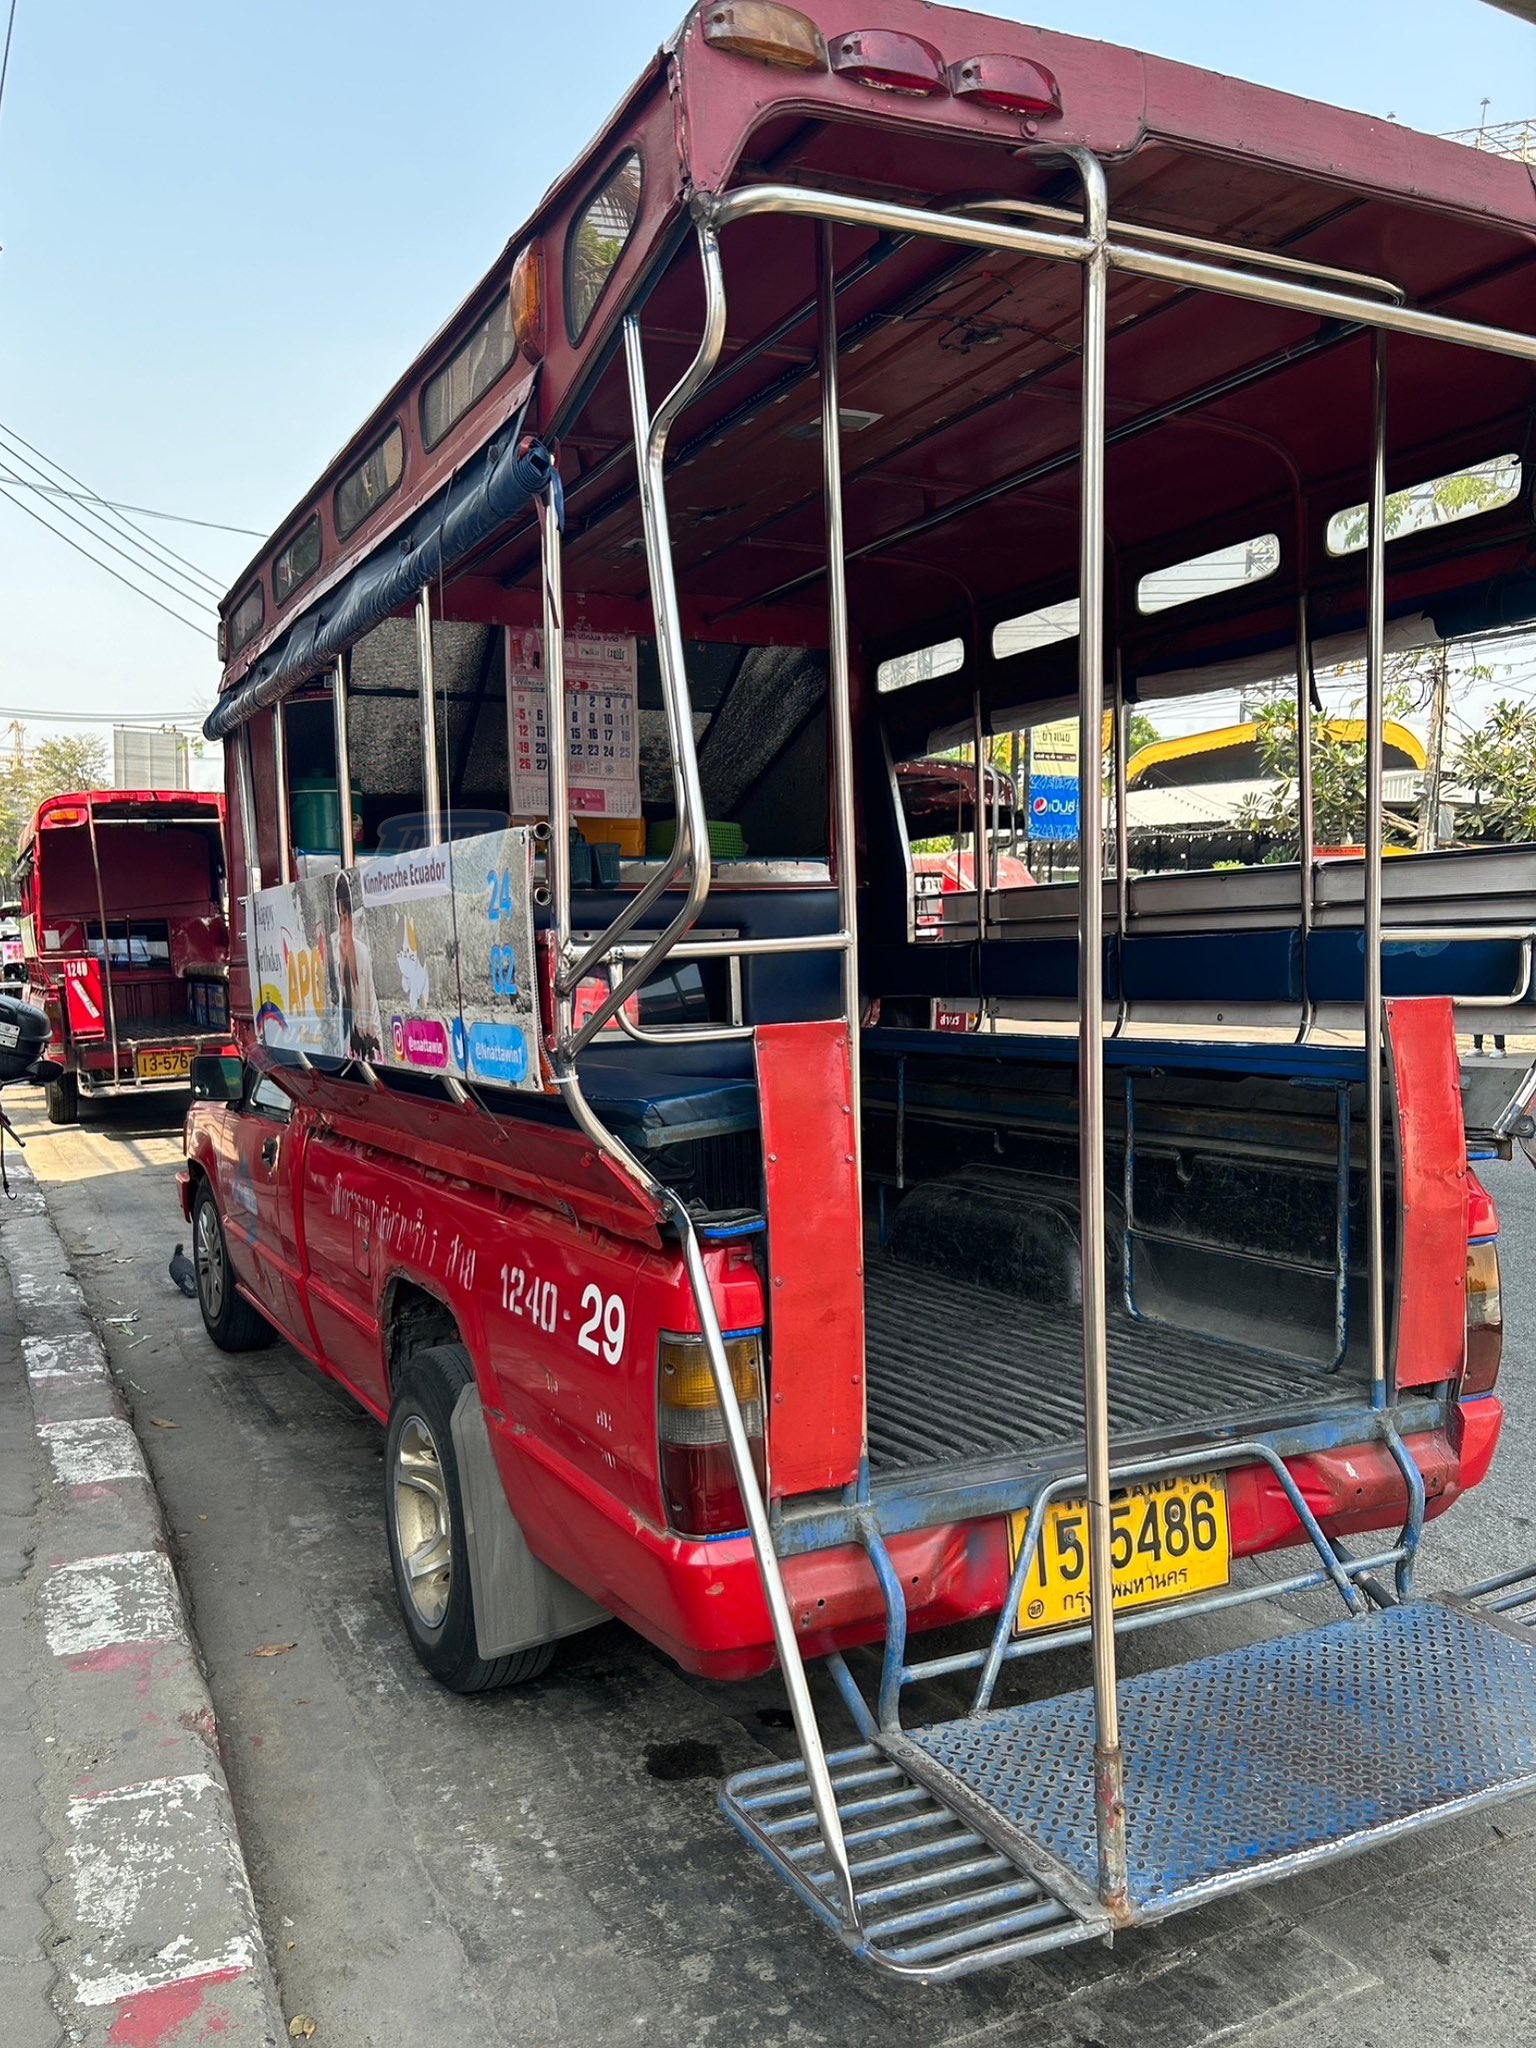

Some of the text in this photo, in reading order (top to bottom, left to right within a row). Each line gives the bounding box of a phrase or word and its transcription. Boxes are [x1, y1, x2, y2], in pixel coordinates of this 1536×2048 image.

[573, 694, 578, 707] 1
[589, 694, 596, 708] 2
[605, 697, 612, 709] 3
[519, 708, 630, 726] 5 6 8 9 10 11
[518, 725, 529, 737] 12
[536, 726, 546, 738] 13
[571, 728, 581, 739] 15
[588, 729, 599, 740] 16
[604, 729, 614, 741] 17
[519, 741, 529, 754] 19
[535, 742, 547, 754] 20
[571, 744, 583, 756] 22
[588, 744, 600, 756] 23
[603, 746, 614, 758] 24
[519, 758, 547, 771] 26 27
[409, 857, 447, 887] Ecuador
[487, 867, 513, 921] 24
[67, 961, 89, 978] 1240
[490, 943, 517, 995] 02
[288, 945, 325, 1018] APO
[143, 1053, 196, 1073] 13-576
[500, 1262, 558, 1333] 1240
[578, 1283, 626, 1365] 29
[1062, 1567, 1188, 1613] กรุงพมหานคร
